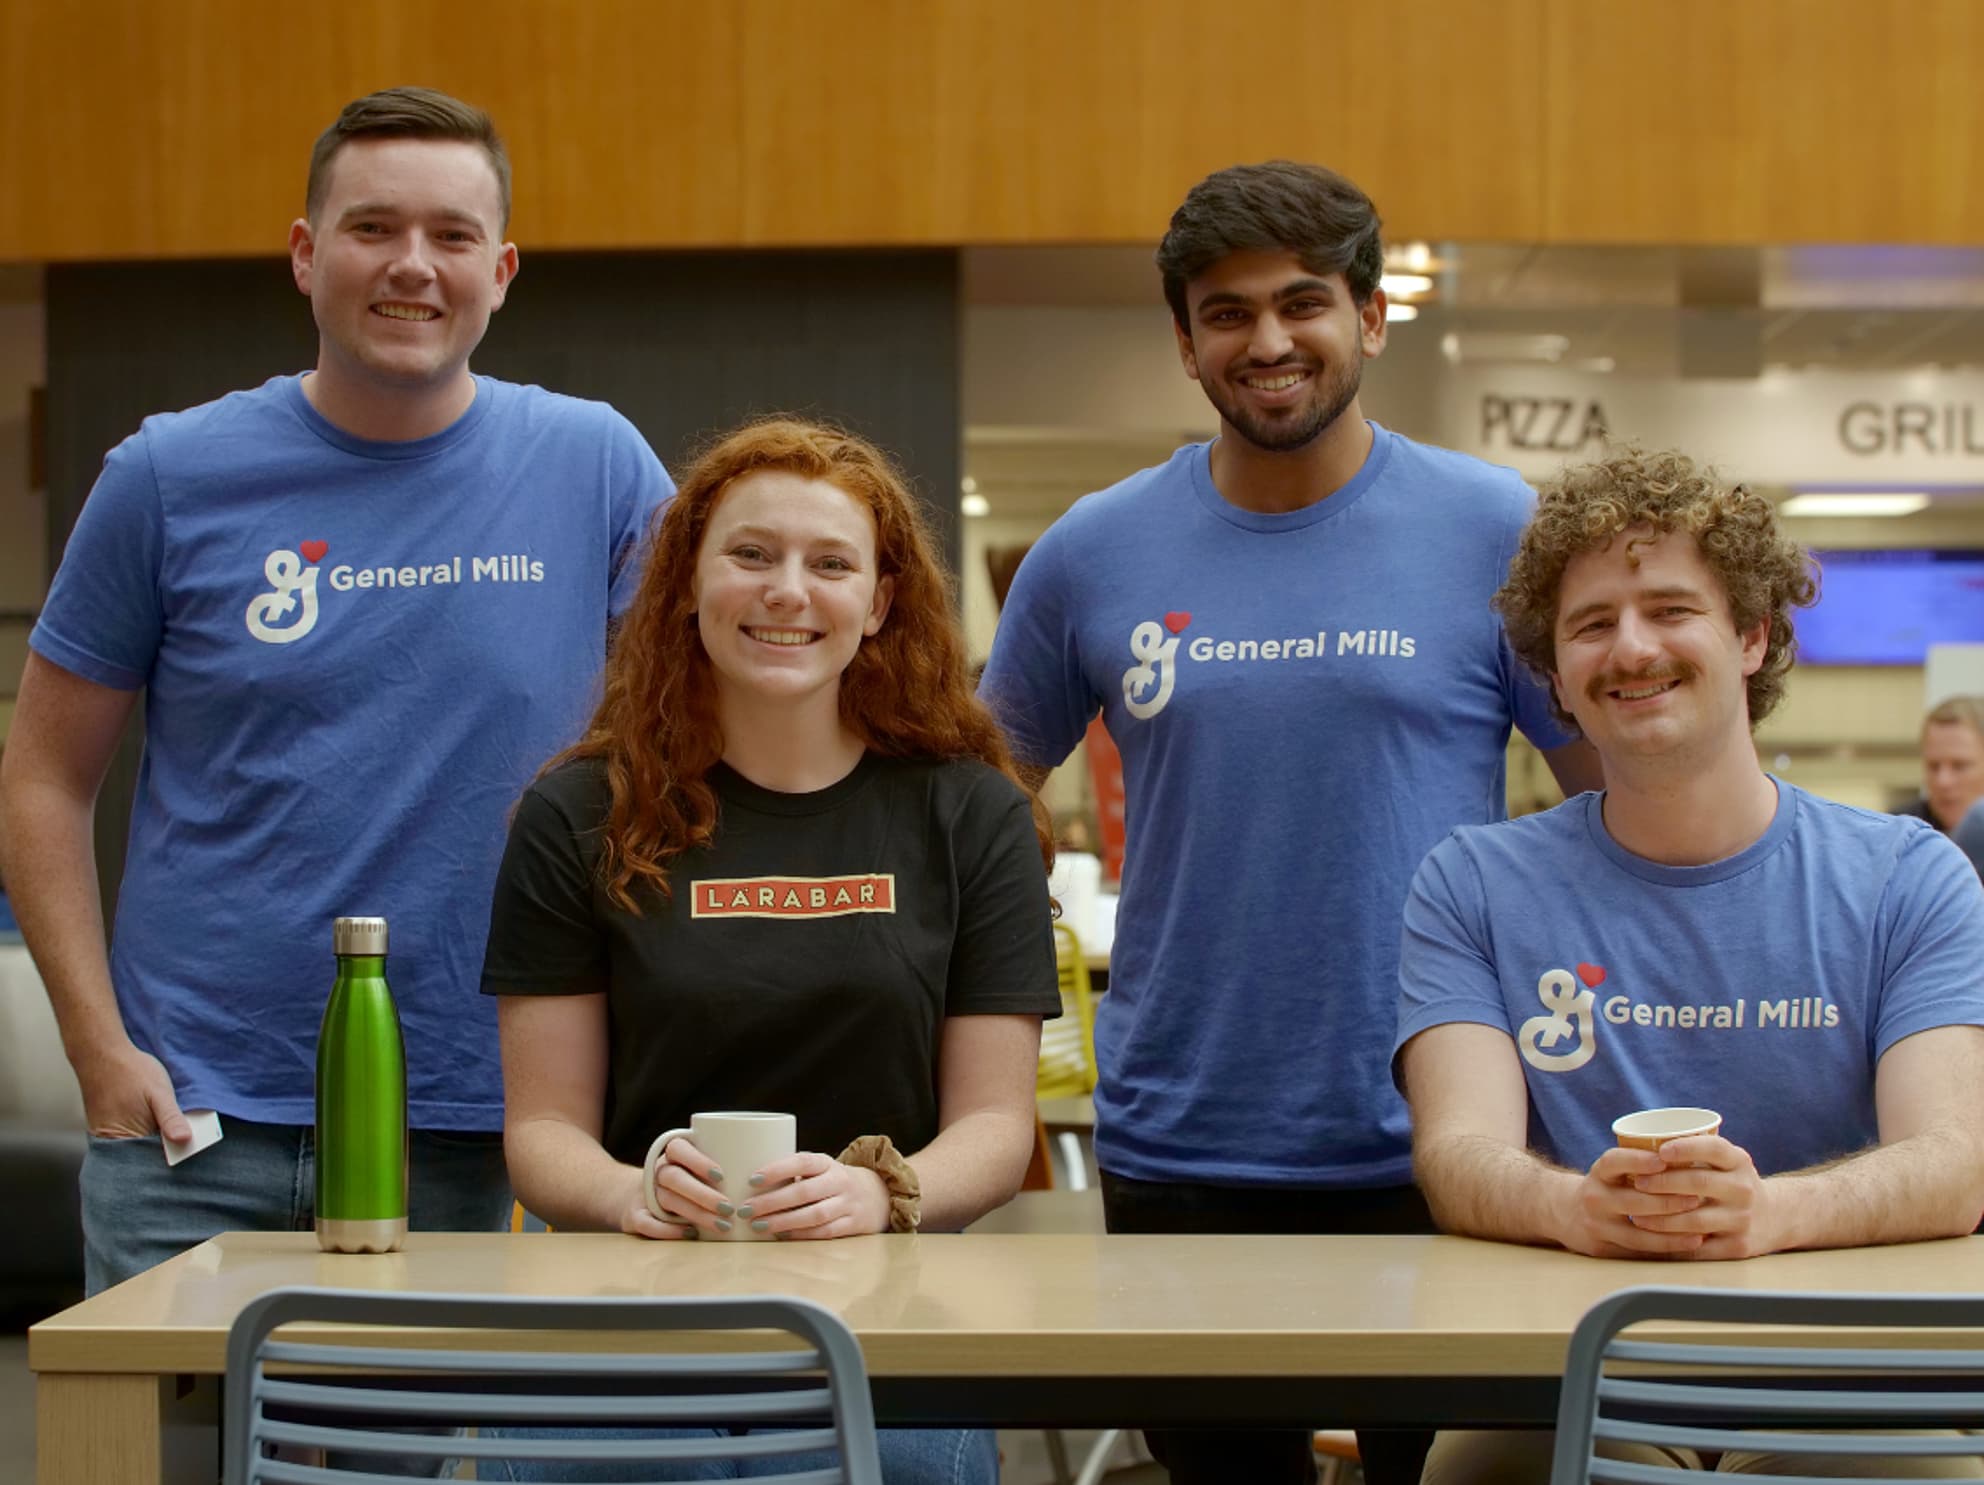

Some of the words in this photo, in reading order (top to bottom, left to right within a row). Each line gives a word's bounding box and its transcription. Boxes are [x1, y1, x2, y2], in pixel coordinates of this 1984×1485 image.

[1481, 394, 1608, 453] PIZZA
[329, 557, 462, 591] General
[472, 555, 545, 583] Mills
[1188, 631, 1326, 662] General
[1336, 629, 1416, 658] Mills
[1603, 996, 1745, 1028] General
[1758, 997, 1839, 1028] Mills
